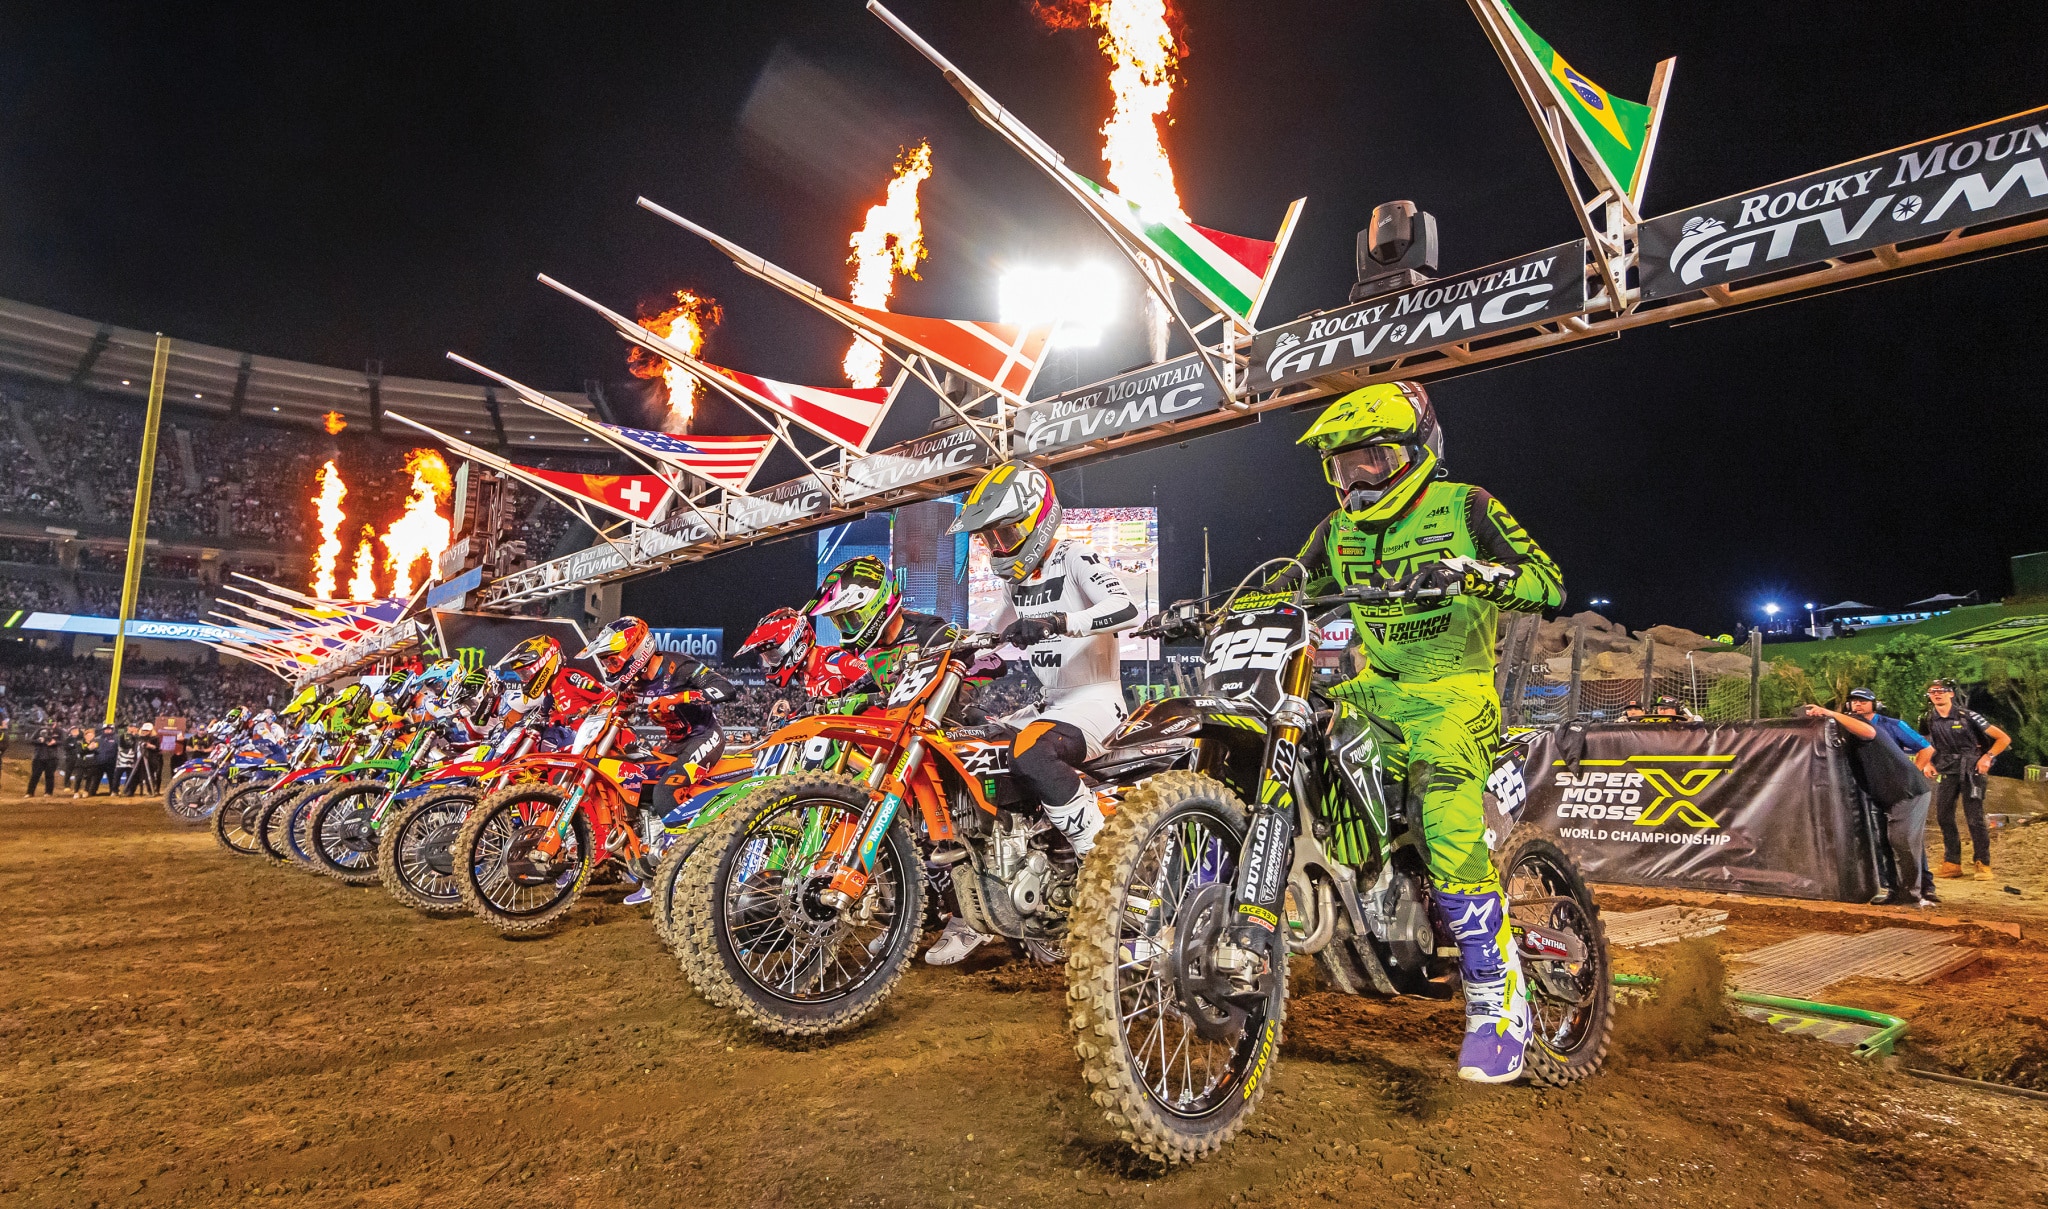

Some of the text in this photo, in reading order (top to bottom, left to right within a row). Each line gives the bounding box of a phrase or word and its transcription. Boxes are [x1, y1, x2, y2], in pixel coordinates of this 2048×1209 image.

[1733, 167, 1884, 229] ROCKY
[1304, 256, 1557, 343] ROCKY MOUNTAIN
[1049, 361, 1204, 421] ROCKY MOUNTAIN
[872, 429, 977, 470] ROCKY MOUNTAIN
[1024, 500, 1061, 564] synchrony
[1372, 544, 1404, 555] TUMPH
[1388, 612, 1452, 633] TRIUMPH
[1388, 623, 1449, 642] RACING
[655, 632, 718, 656] Modelo
[1031, 650, 1062, 668] KTM
[1204, 627, 1293, 680] 325
[1160, 718, 1191, 735] TRIUMPH
[1349, 737, 1374, 763] TRIUMPH
[1486, 760, 1527, 816] 325
[1554, 772, 1645, 788] SUPER
[1561, 787, 1640, 804] MOTO
[748, 794, 798, 831] DUNLOP
[869, 797, 897, 843] MOTOREX
[1556, 804, 1644, 821] CROSS
[1265, 818, 1283, 886] PERFORMANCE
[1559, 828, 1731, 846] WORLD CHAMPIONSHIP
[1243, 1026, 1275, 1100] DUNLOP
